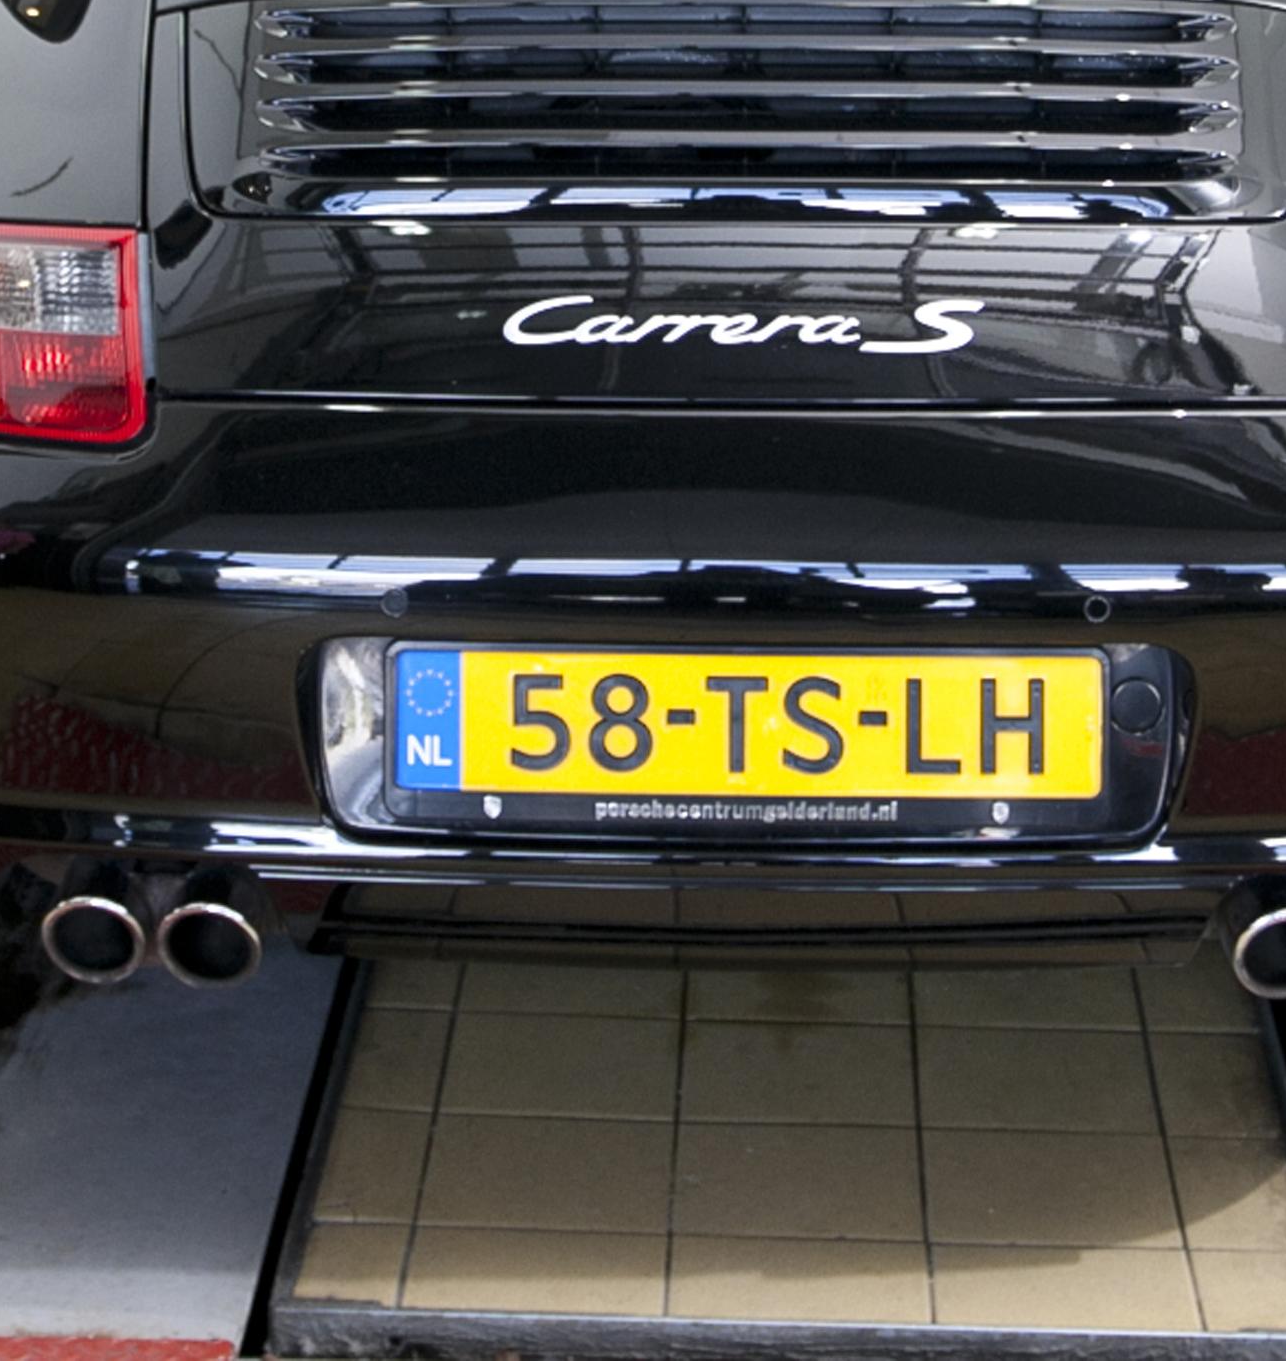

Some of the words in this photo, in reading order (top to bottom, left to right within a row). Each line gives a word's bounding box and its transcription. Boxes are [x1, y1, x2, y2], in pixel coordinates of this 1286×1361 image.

[503, 294, 861, 344] Carrera
[859, 299, 985, 354] S
[407, 735, 452, 767] NL
[510, 673, 1046, 776] 58-TS-LH
